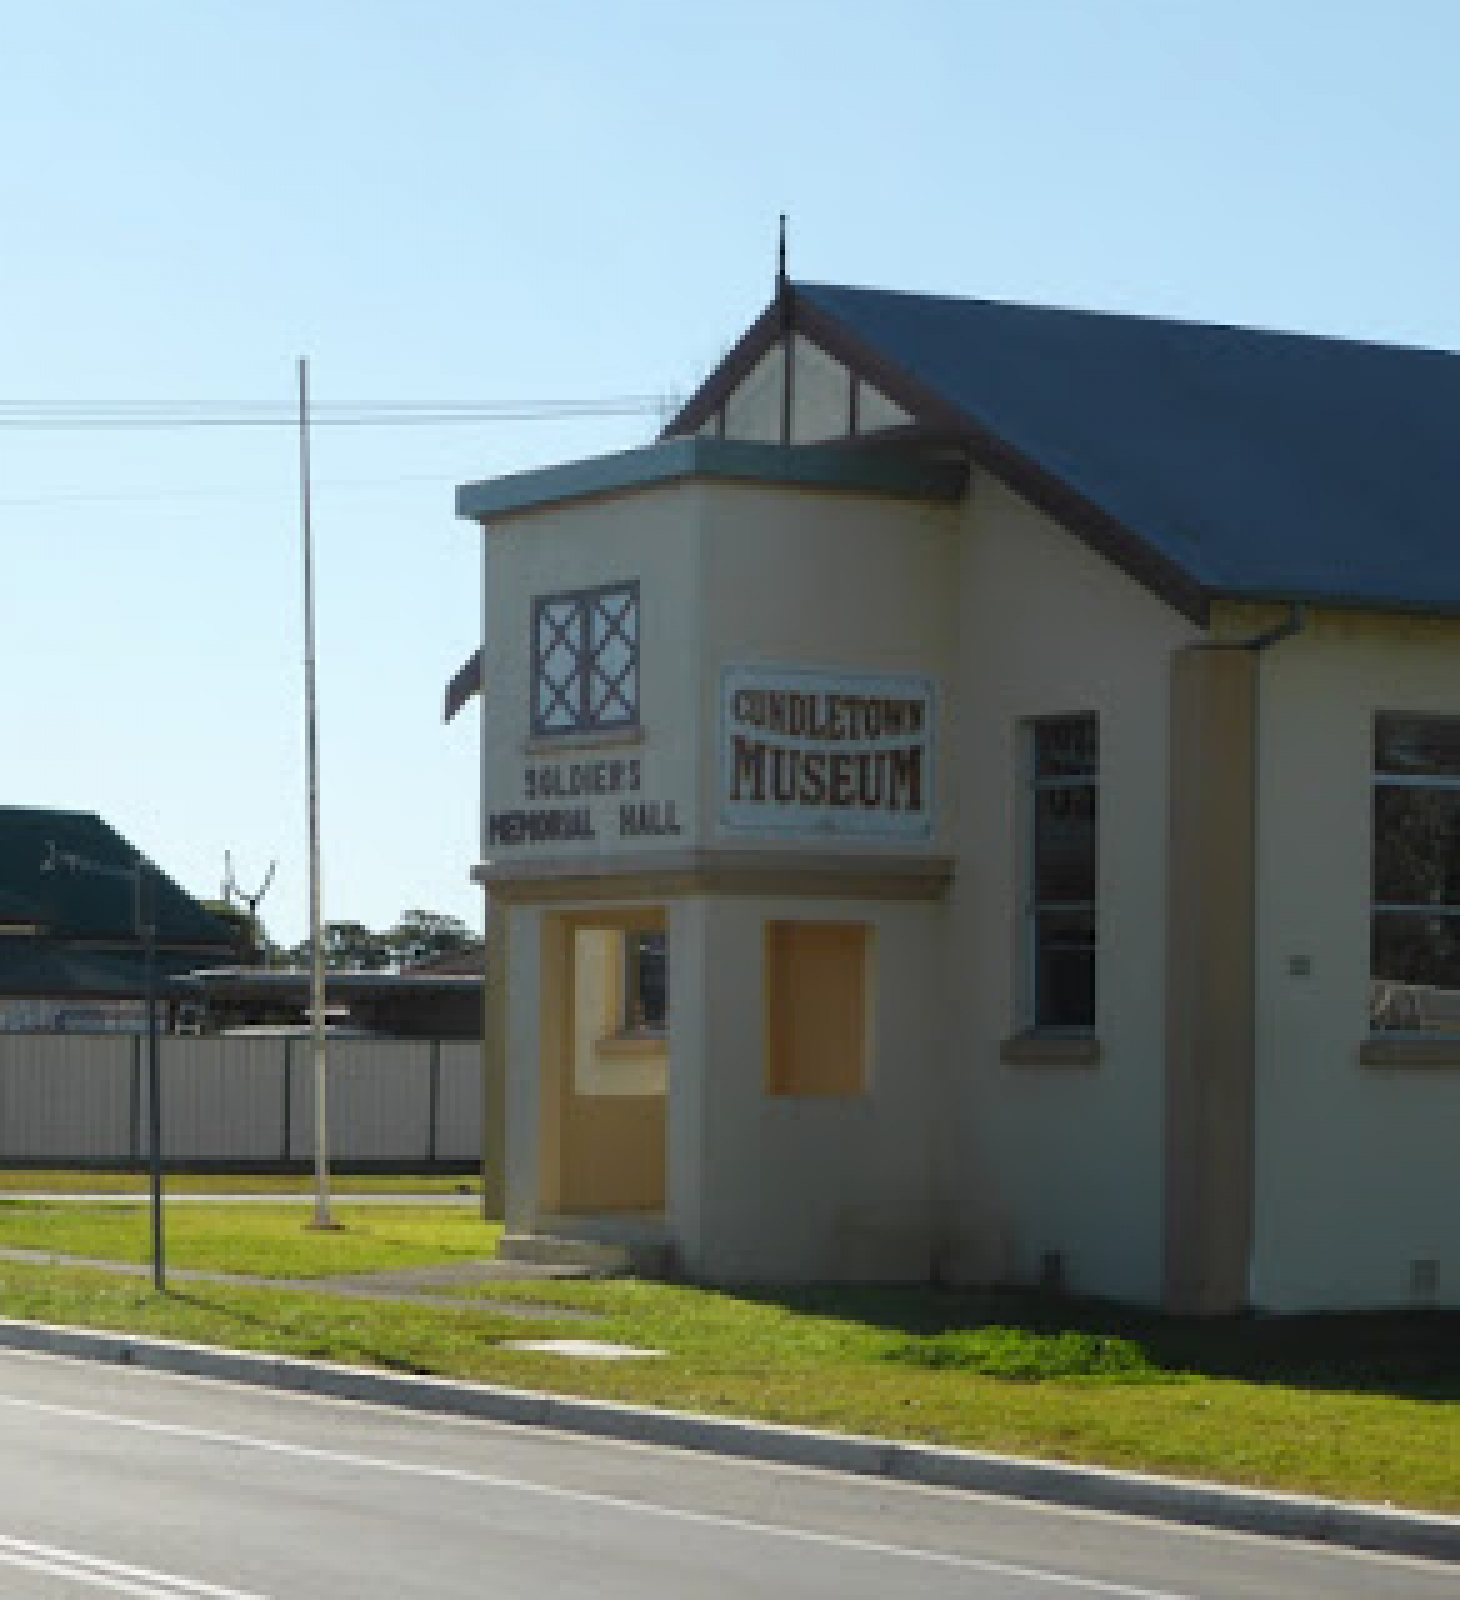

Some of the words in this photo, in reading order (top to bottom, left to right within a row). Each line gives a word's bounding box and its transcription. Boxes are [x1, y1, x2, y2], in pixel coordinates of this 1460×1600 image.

[733, 690, 926, 741] CUNDLETOWN
[524, 760, 641, 800] SOLDIERS
[730, 736, 922, 811] MUSEUM
[489, 810, 596, 845] MEMORIAL
[618, 801, 681, 836] HALL
